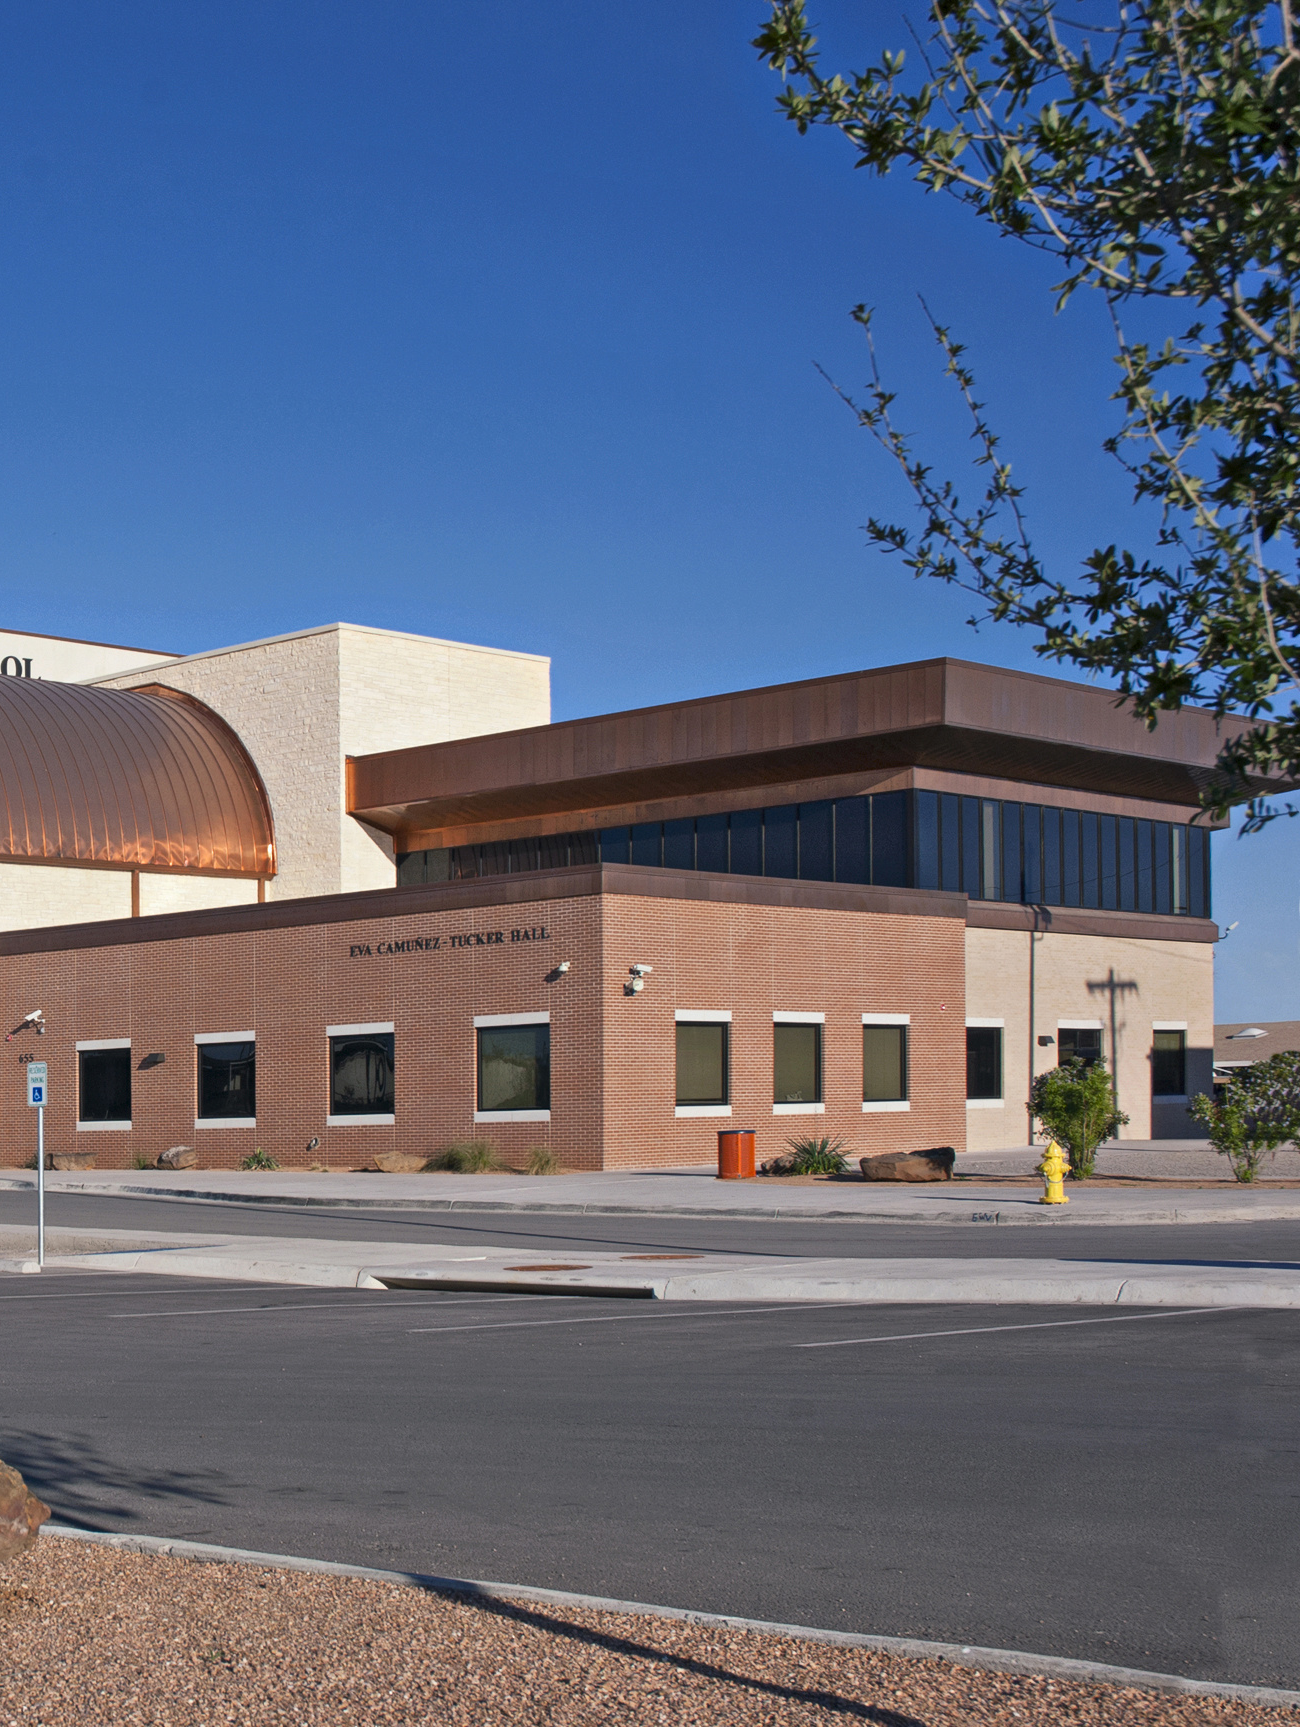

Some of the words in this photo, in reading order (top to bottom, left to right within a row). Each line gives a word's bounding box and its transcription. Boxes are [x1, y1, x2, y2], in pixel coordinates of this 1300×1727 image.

[349, 944, 372, 957] EVA
[510, 927, 550, 942] HALL
[19, 1053, 34, 1063] 655
